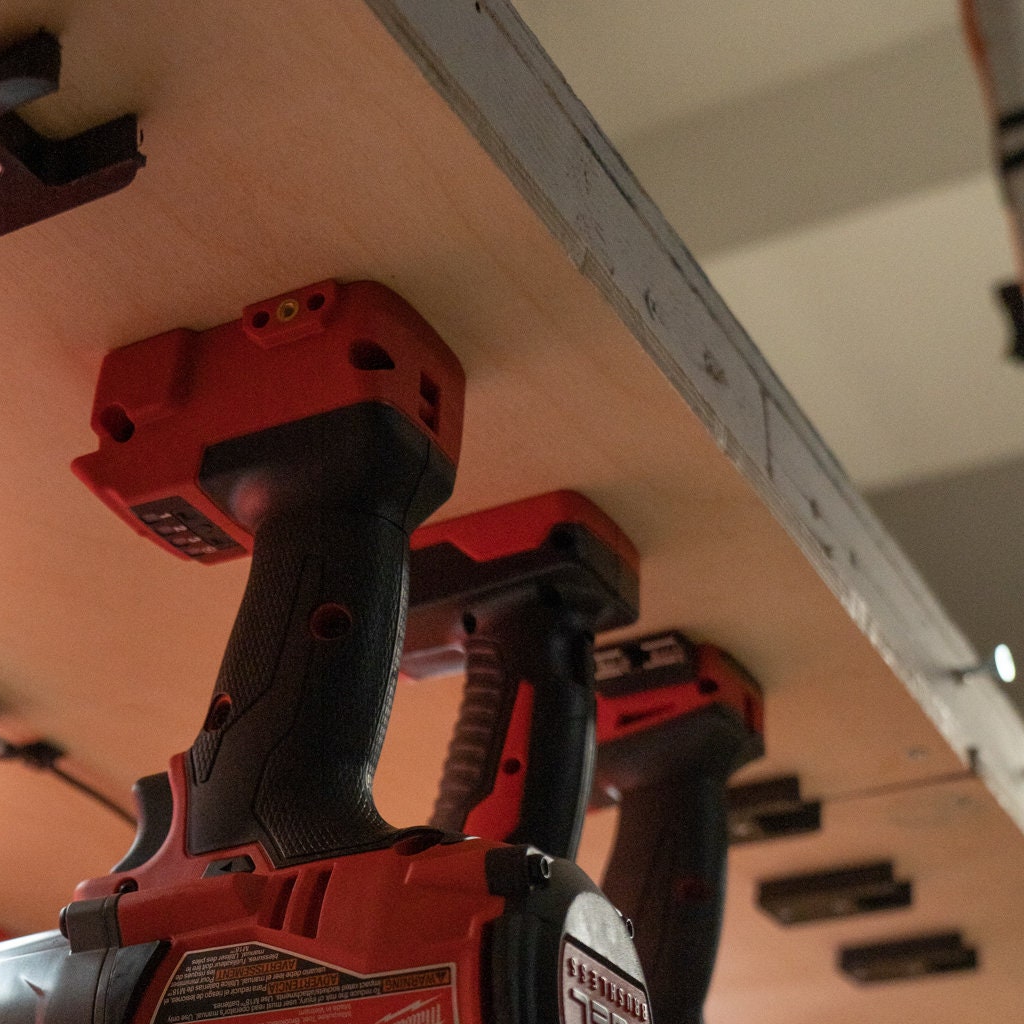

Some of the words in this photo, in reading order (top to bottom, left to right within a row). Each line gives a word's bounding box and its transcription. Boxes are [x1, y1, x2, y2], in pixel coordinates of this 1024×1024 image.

[214, 959, 295, 980] AVERTISSEMENT
[252, 984, 267, 992] Para
[267, 974, 337, 993] ADVERTENCIA
[384, 973, 435, 990] WARNING
[566, 956, 647, 1021] BRUSHLESS
